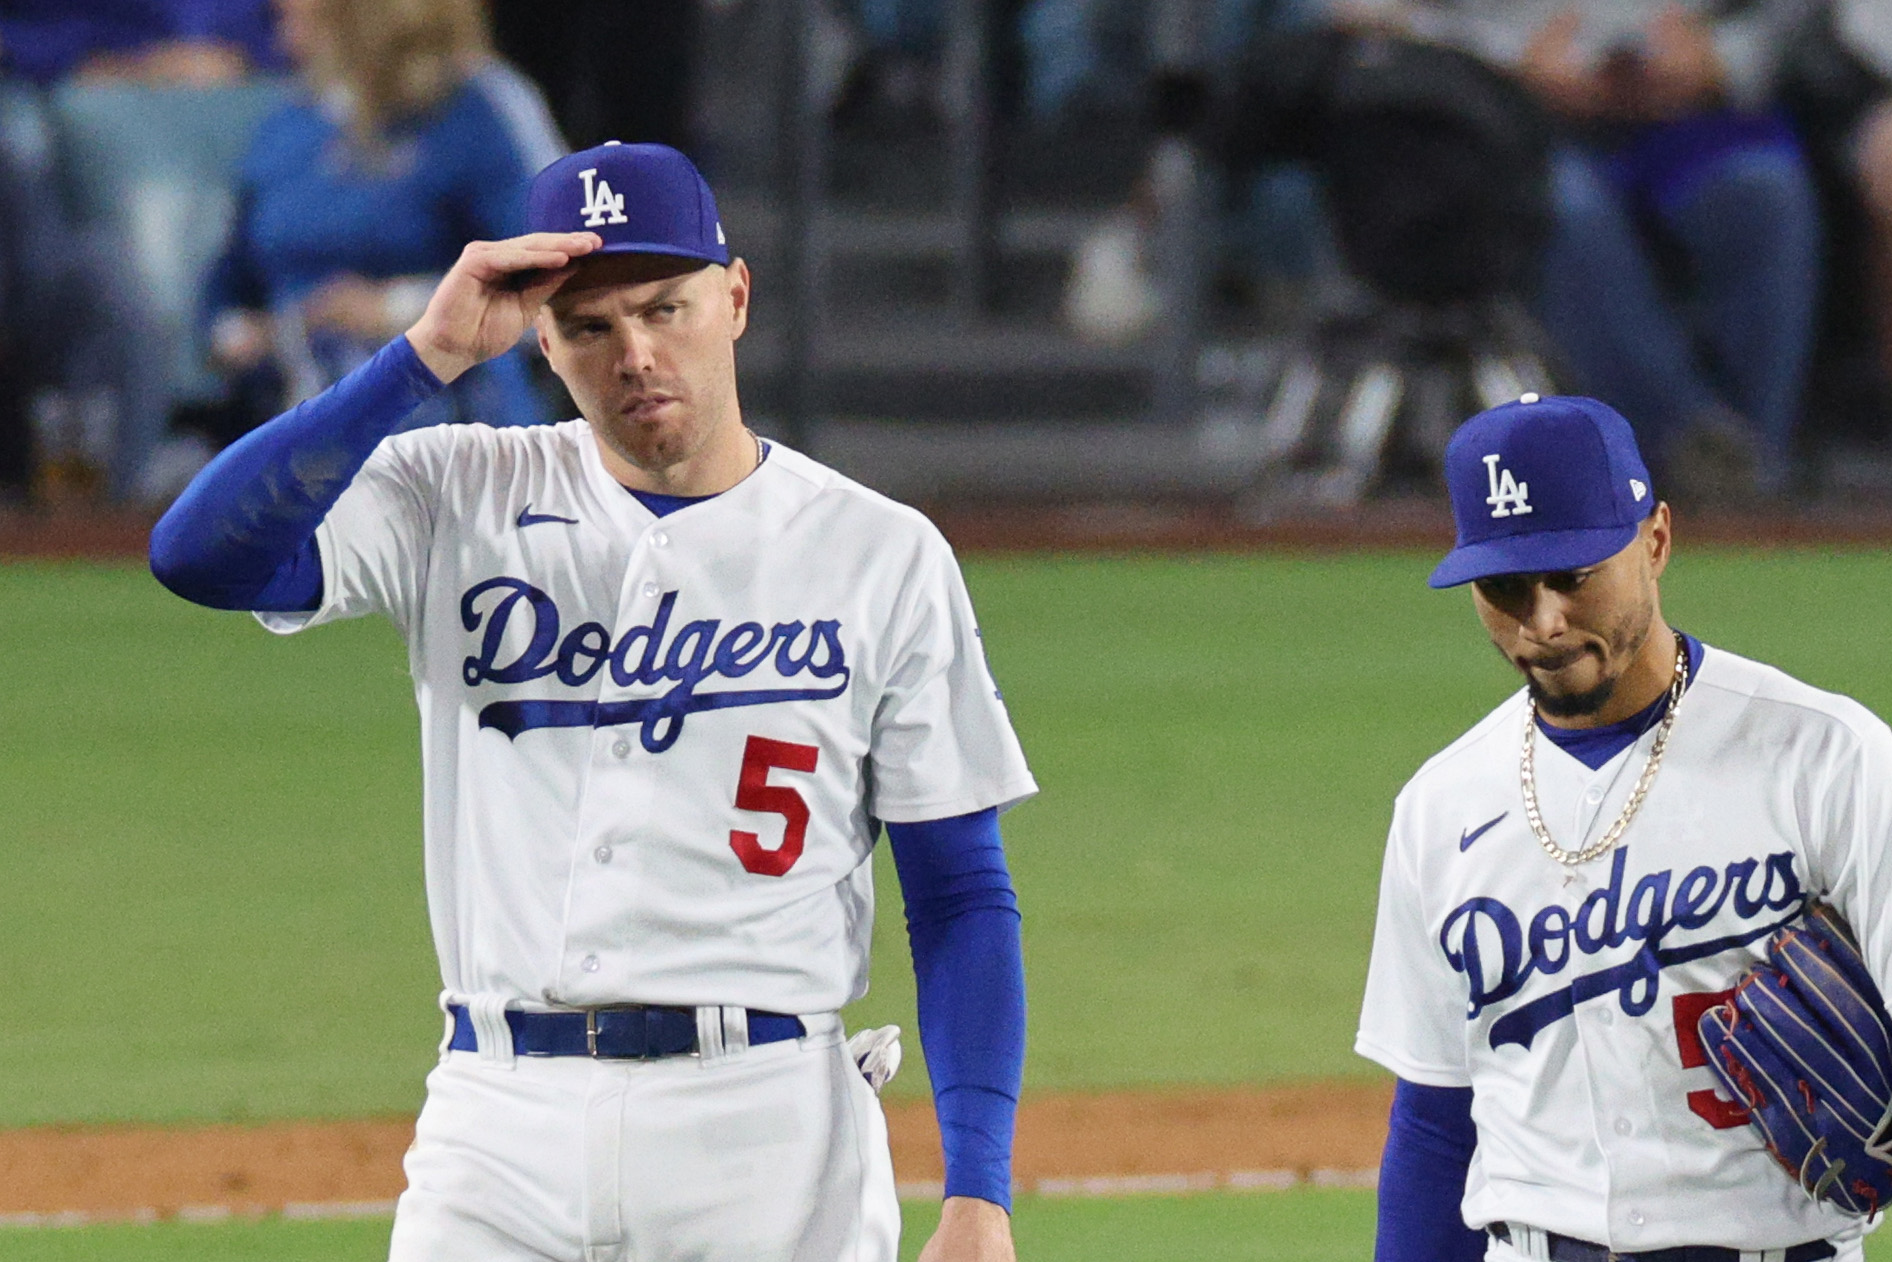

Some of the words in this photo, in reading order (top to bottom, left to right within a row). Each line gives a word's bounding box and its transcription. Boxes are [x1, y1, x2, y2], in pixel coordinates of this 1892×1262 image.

[578, 168, 628, 227] LA
[1482, 454, 1533, 518] LA
[461, 577, 850, 754] Dodgers
[729, 735, 819, 877] 5
[1440, 846, 1803, 1024] Dodgers
